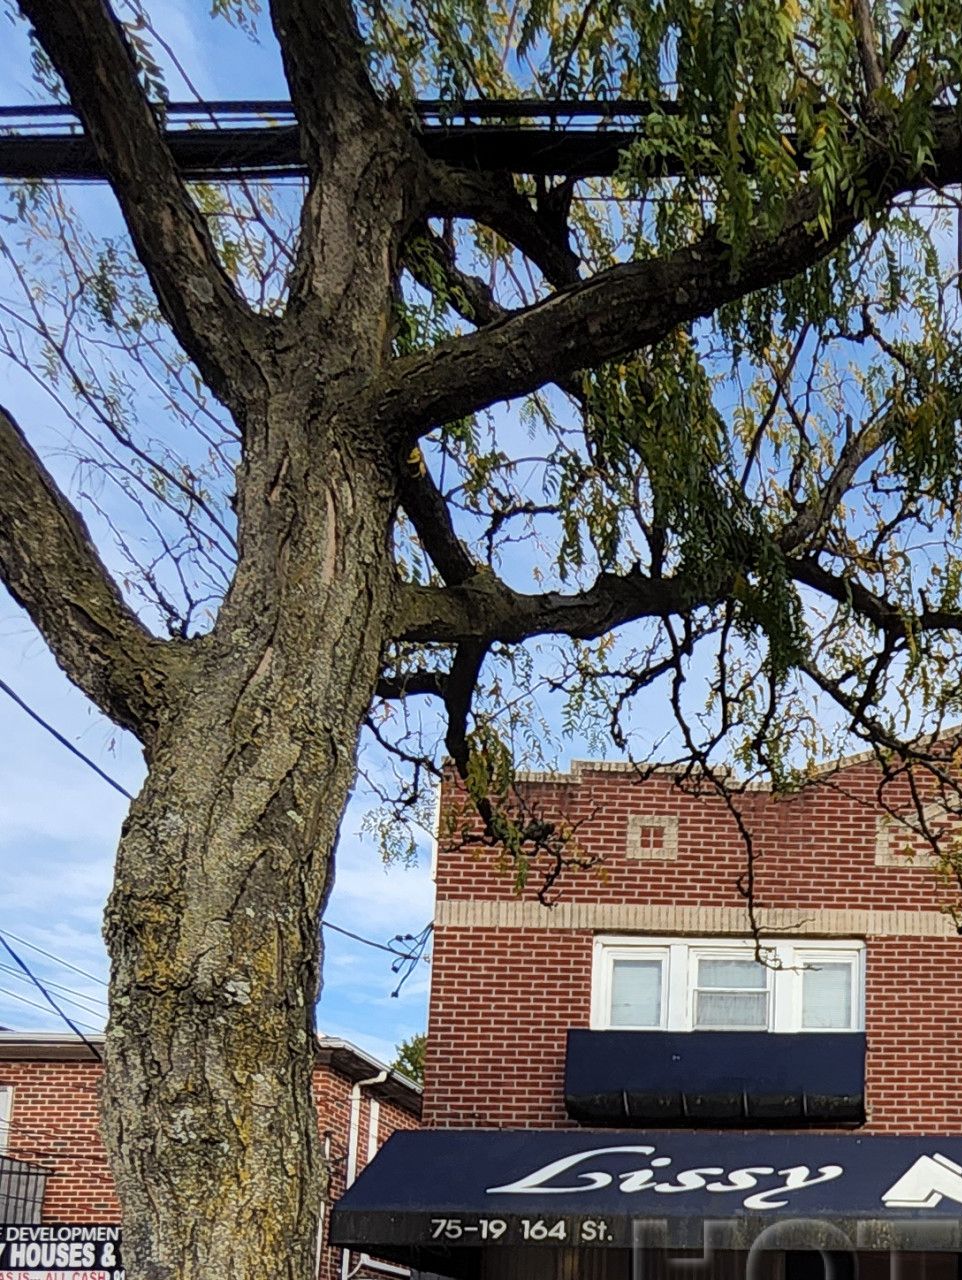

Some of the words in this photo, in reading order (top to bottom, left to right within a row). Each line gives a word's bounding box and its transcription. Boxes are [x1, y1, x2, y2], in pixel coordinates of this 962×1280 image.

[486, 1144, 844, 1210] Lissy
[6, 1227, 124, 1242] DEVELOPMEN
[430, 1218, 507, 1239] 75-19
[521, 1219, 567, 1240] 164
[581, 1219, 613, 1241] St.
[10, 1242, 95, 1268] HOUSES
[101, 1242, 116, 1268] &
